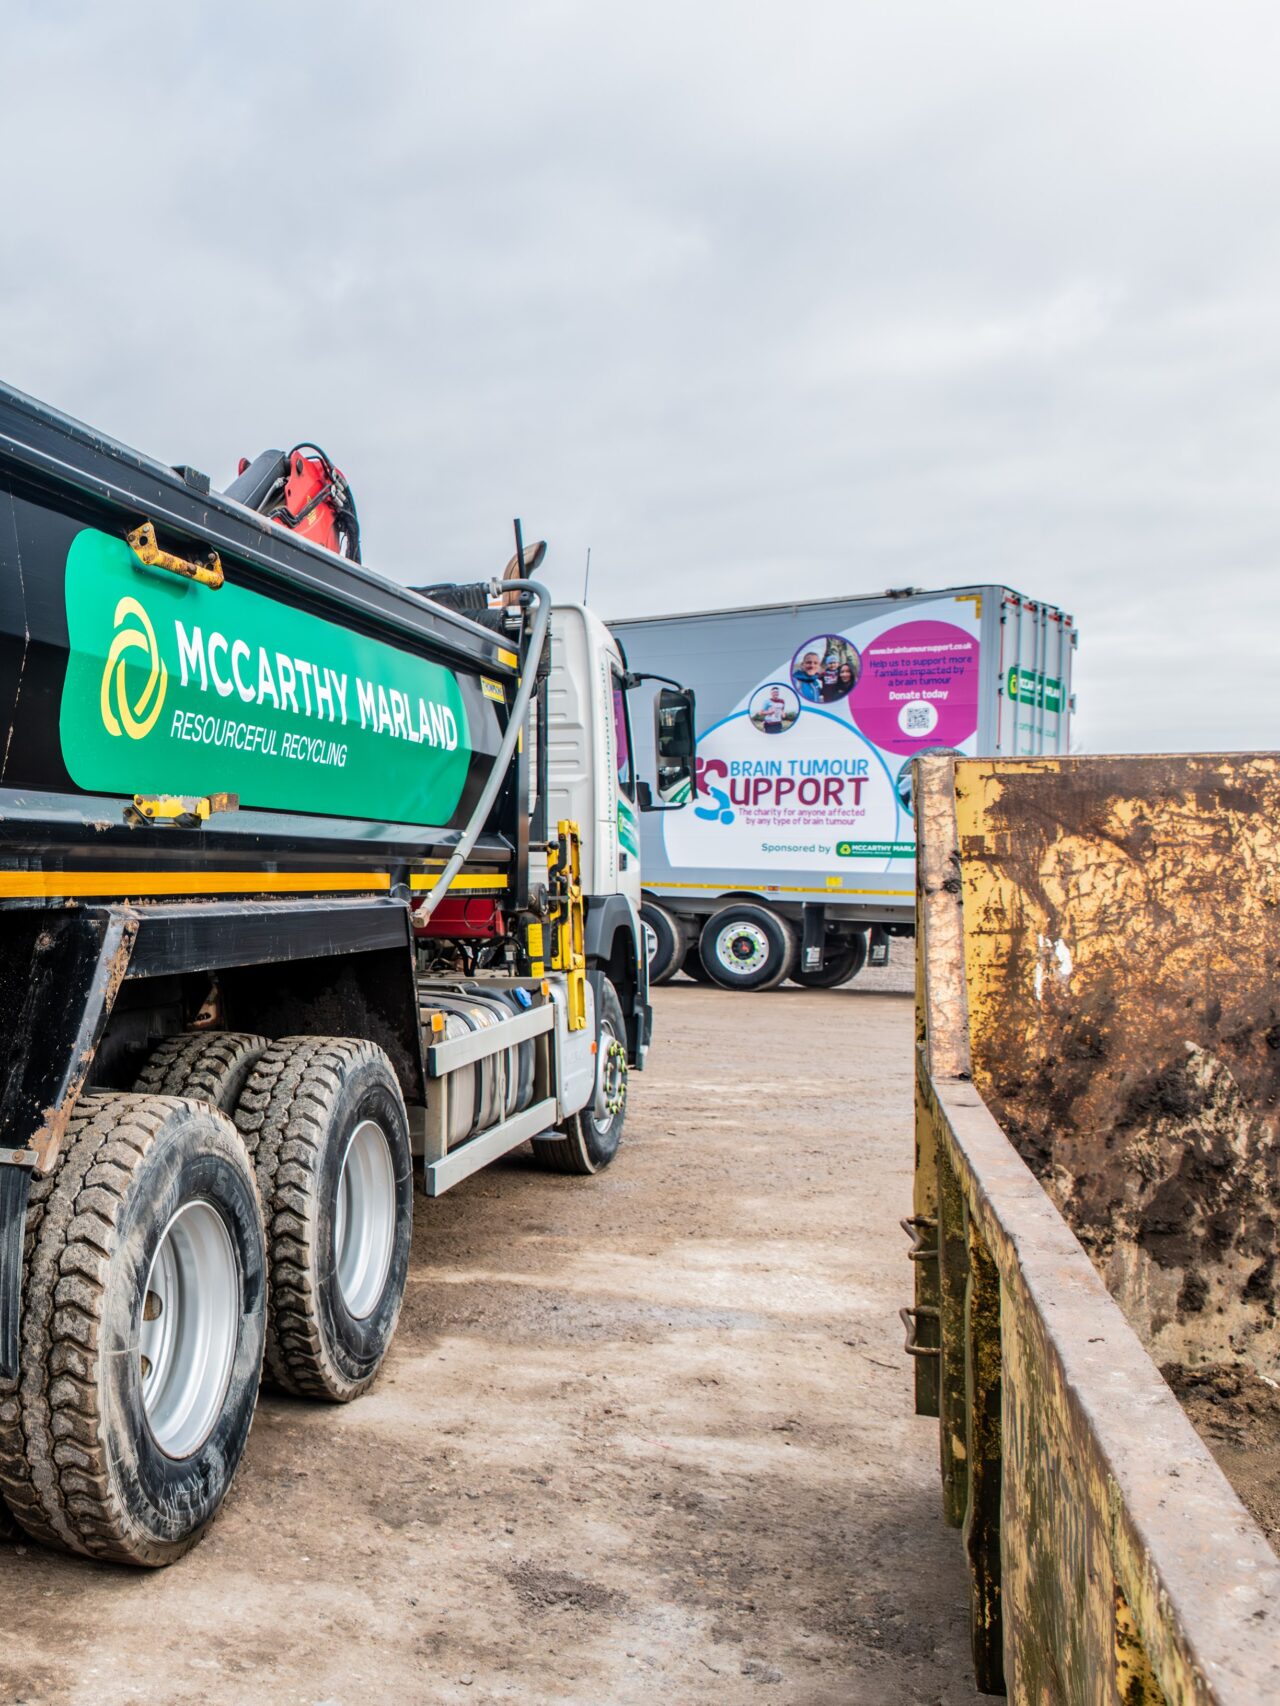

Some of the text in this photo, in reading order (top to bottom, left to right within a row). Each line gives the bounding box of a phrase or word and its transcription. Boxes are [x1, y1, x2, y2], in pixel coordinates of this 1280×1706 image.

[870, 659, 887, 669] Help
[913, 656, 946, 667] support
[875, 666, 964, 678] families impacted by
[174, 619, 458, 752] MCCARTHY MARLAND
[895, 678, 917, 686] brain
[919, 677, 951, 685] tumour
[889, 689, 948, 701] Donate today
[170, 710, 348, 768] RESOURCEFUL RECYCLING
[730, 759, 869, 777] BRAIN TUMOUR
[738, 807, 865, 817] The charity for anyone affected
[746, 817, 856, 826] by any type of brain tumour
[761, 843, 831, 855] Sponsored by
[852, 844, 891, 852] MCCARTHY
